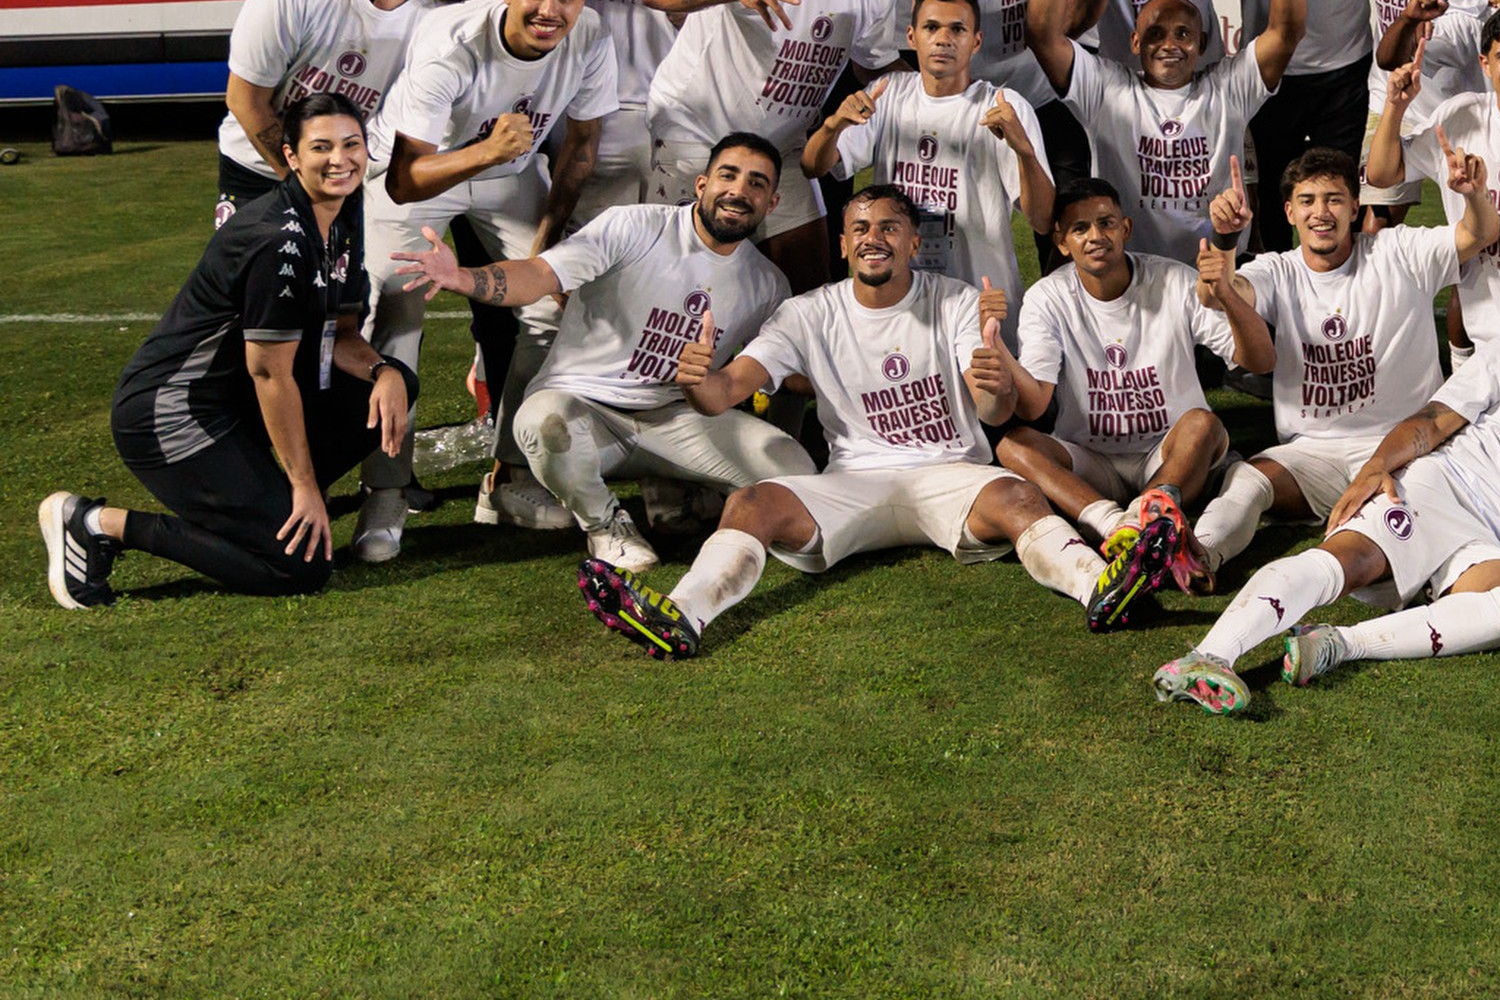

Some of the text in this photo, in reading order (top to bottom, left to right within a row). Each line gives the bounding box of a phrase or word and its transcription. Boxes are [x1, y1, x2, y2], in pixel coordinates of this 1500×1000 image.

[1302, 333, 1373, 365] MOLEQUE
[1303, 356, 1376, 386] TRAVESSO
[860, 371, 946, 414] MOLEQUE
[1088, 388, 1166, 412] TRAVESSO
[1301, 375, 1375, 408] VOLTOU!
[866, 396, 952, 435] TRAVESSO
[1089, 408, 1170, 438] VOLTOU!
